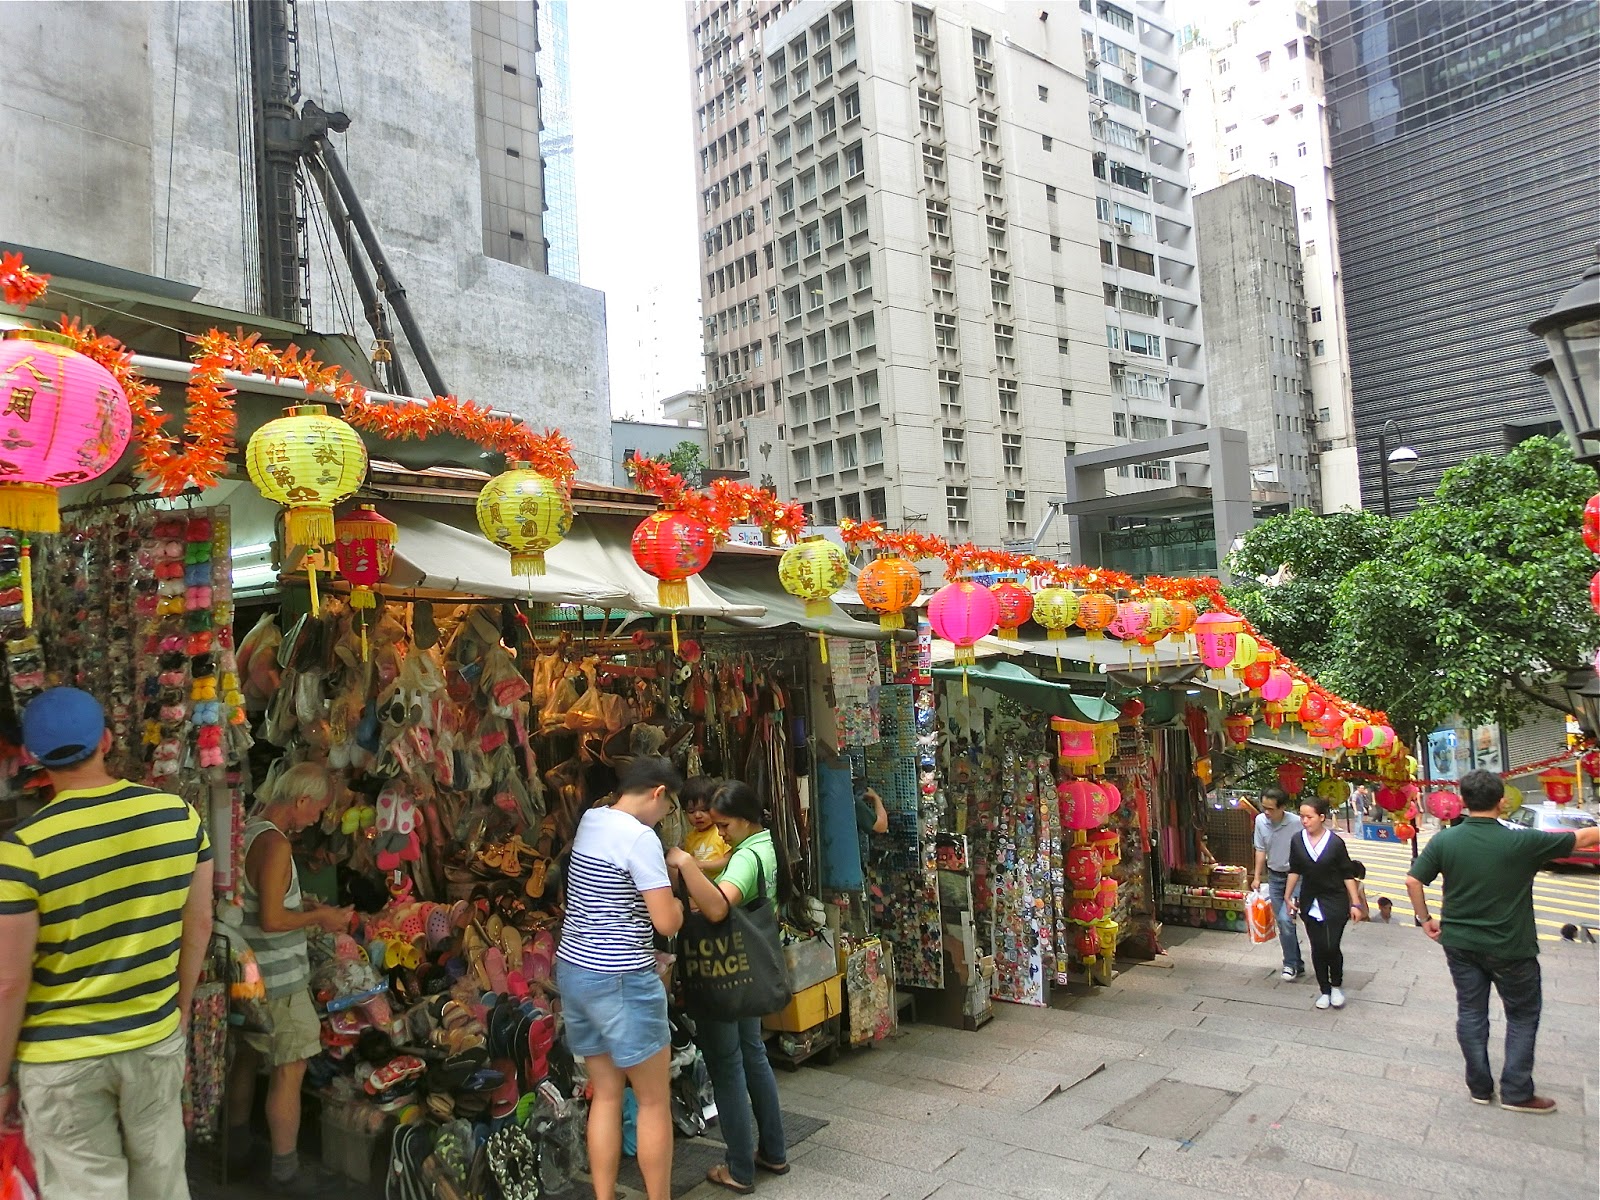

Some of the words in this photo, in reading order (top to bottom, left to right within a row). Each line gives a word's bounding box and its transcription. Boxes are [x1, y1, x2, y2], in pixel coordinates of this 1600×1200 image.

[2, 355, 53, 423] 人月
[309, 421, 344, 466] 中秋
[684, 931, 745, 956] LOVE
[686, 953, 750, 977] PEACE
